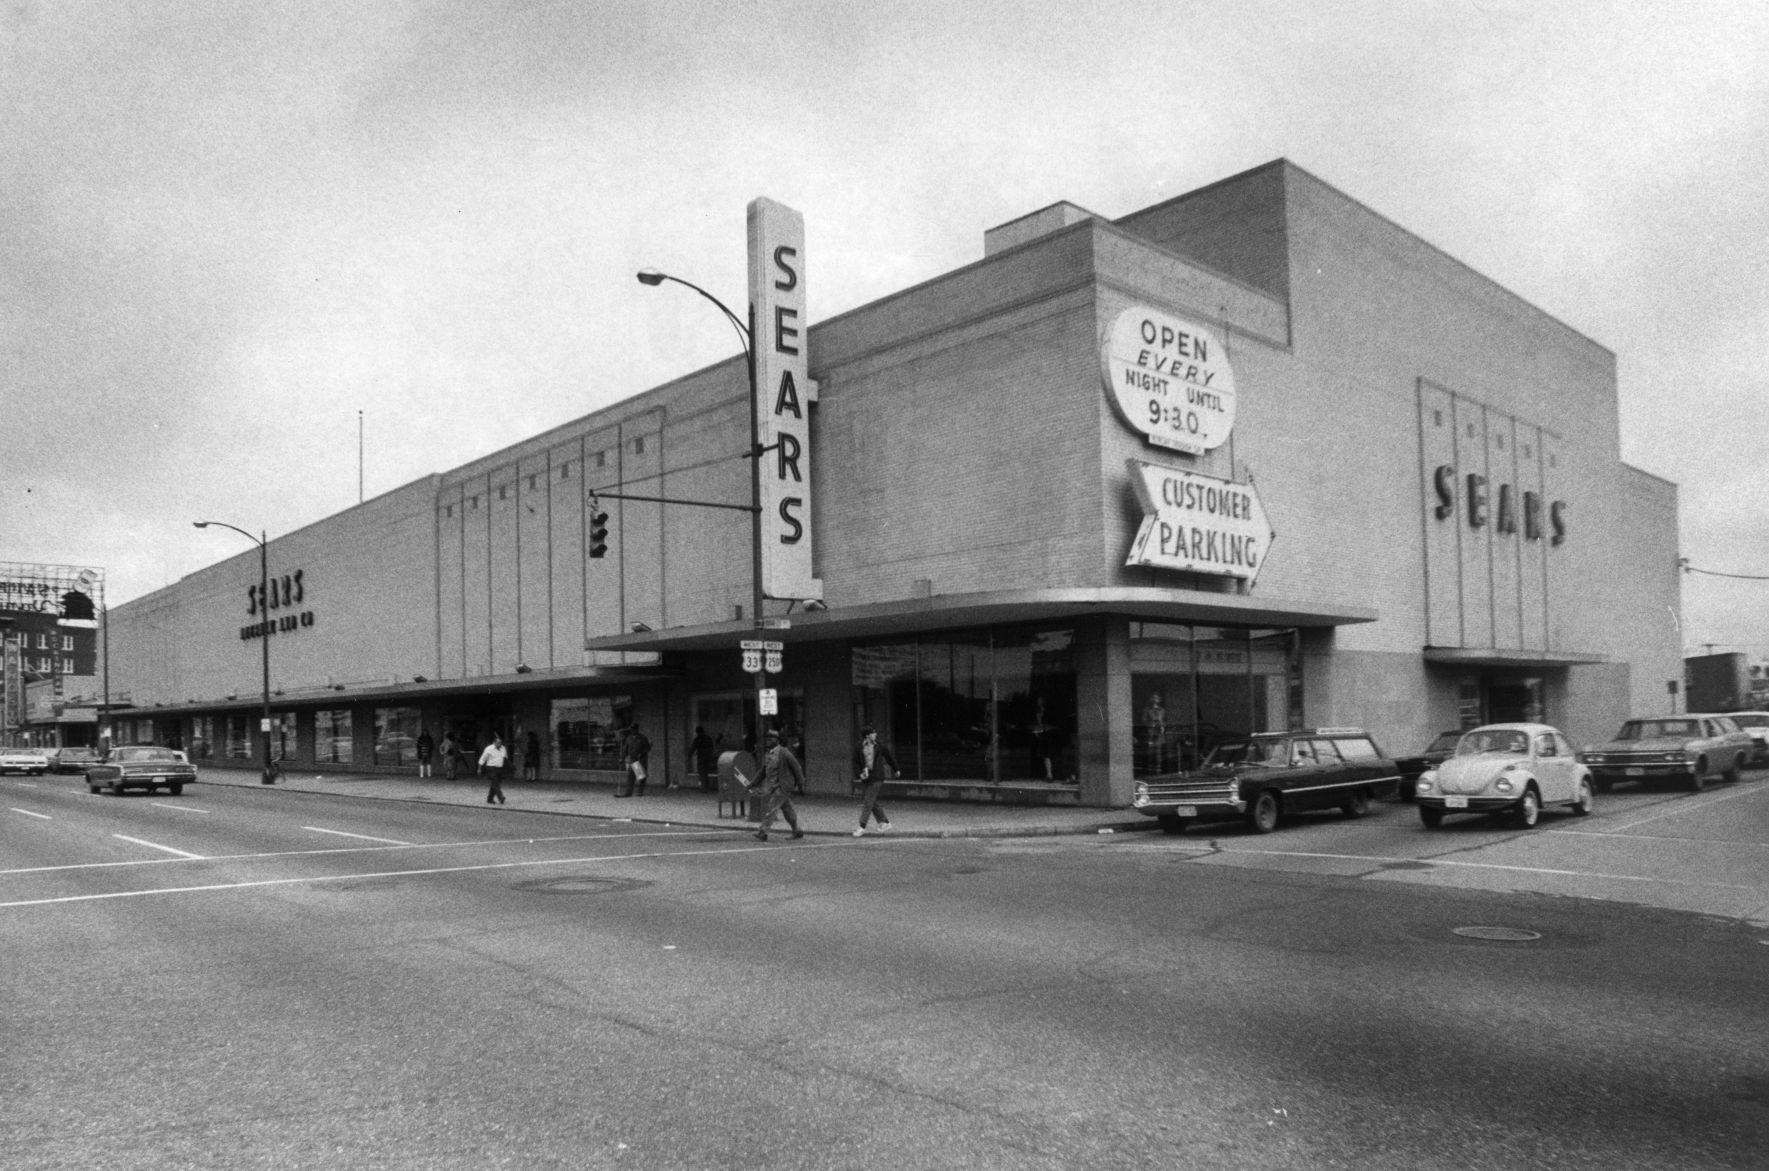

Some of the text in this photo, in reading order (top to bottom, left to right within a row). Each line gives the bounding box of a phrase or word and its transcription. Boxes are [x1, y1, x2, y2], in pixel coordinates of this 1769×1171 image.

[1141, 319, 1207, 362] OPEN
[1137, 349, 1214, 386] EVERY
[773, 245, 803, 545] SEARS
[1125, 368, 1225, 413] NIGHT UNTIL
[1148, 399, 1199, 434] 9:30
[1162, 477, 1252, 521] CUSTOMER
[1434, 464, 1567, 548] SEARS
[1160, 522, 1257, 568] PARKING
[746, 656, 758, 668] 33
[768, 657, 780, 668] 250
